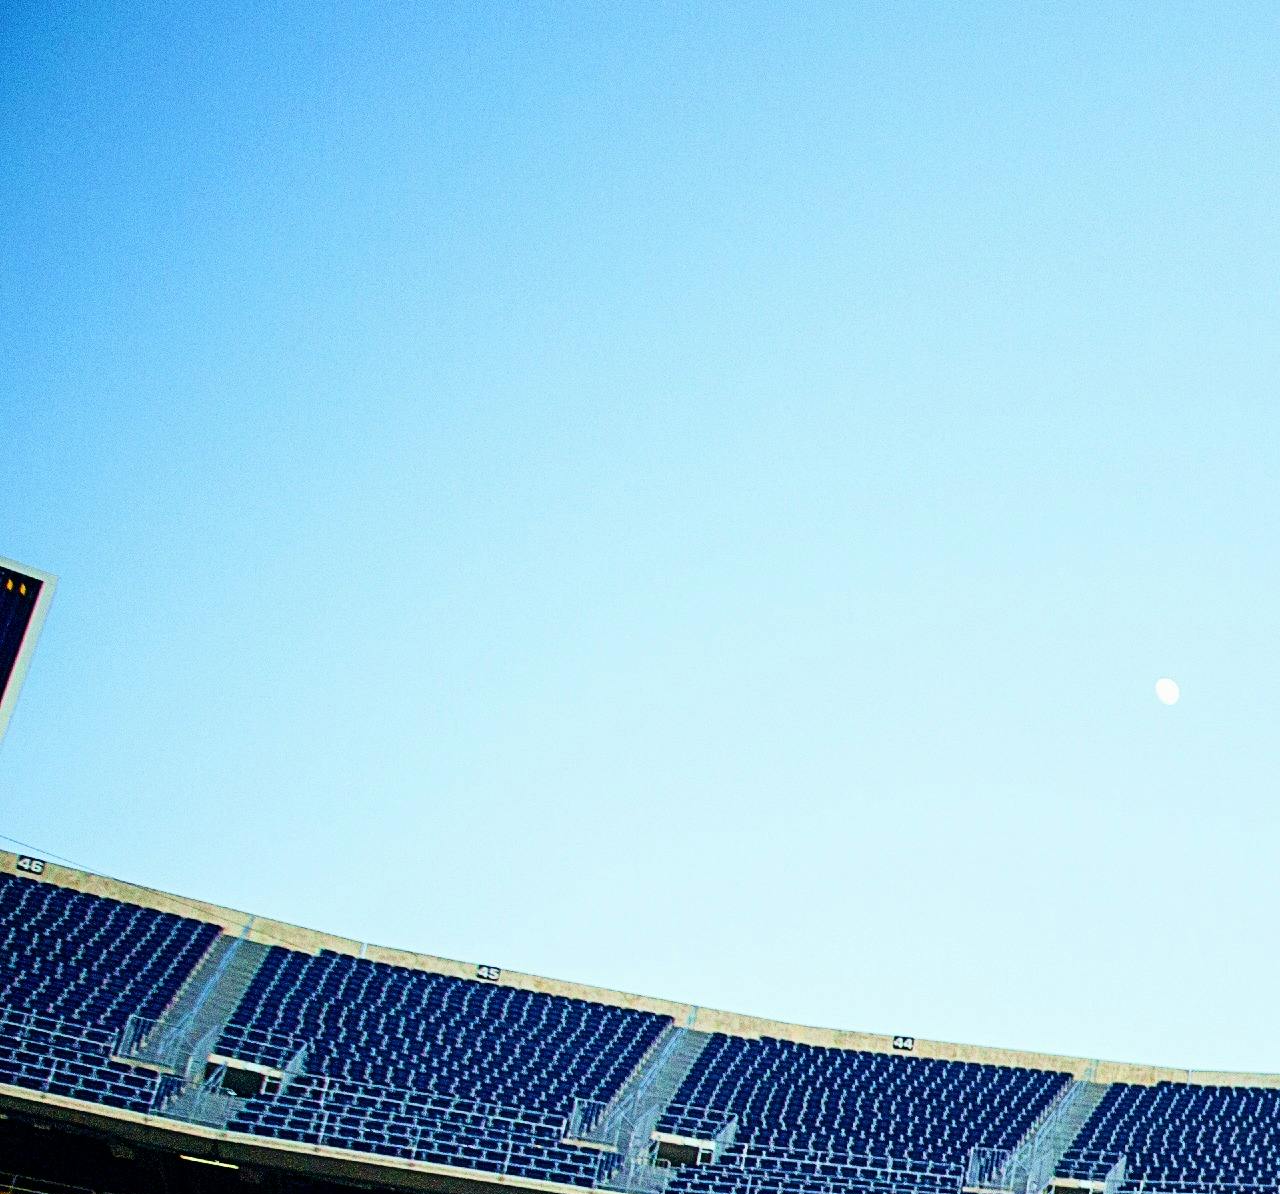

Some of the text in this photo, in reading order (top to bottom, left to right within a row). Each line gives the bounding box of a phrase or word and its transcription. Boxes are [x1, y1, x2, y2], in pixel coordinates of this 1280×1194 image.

[19, 857, 43, 874] 46
[478, 966, 500, 980] 45
[893, 1037, 913, 1050] 44
